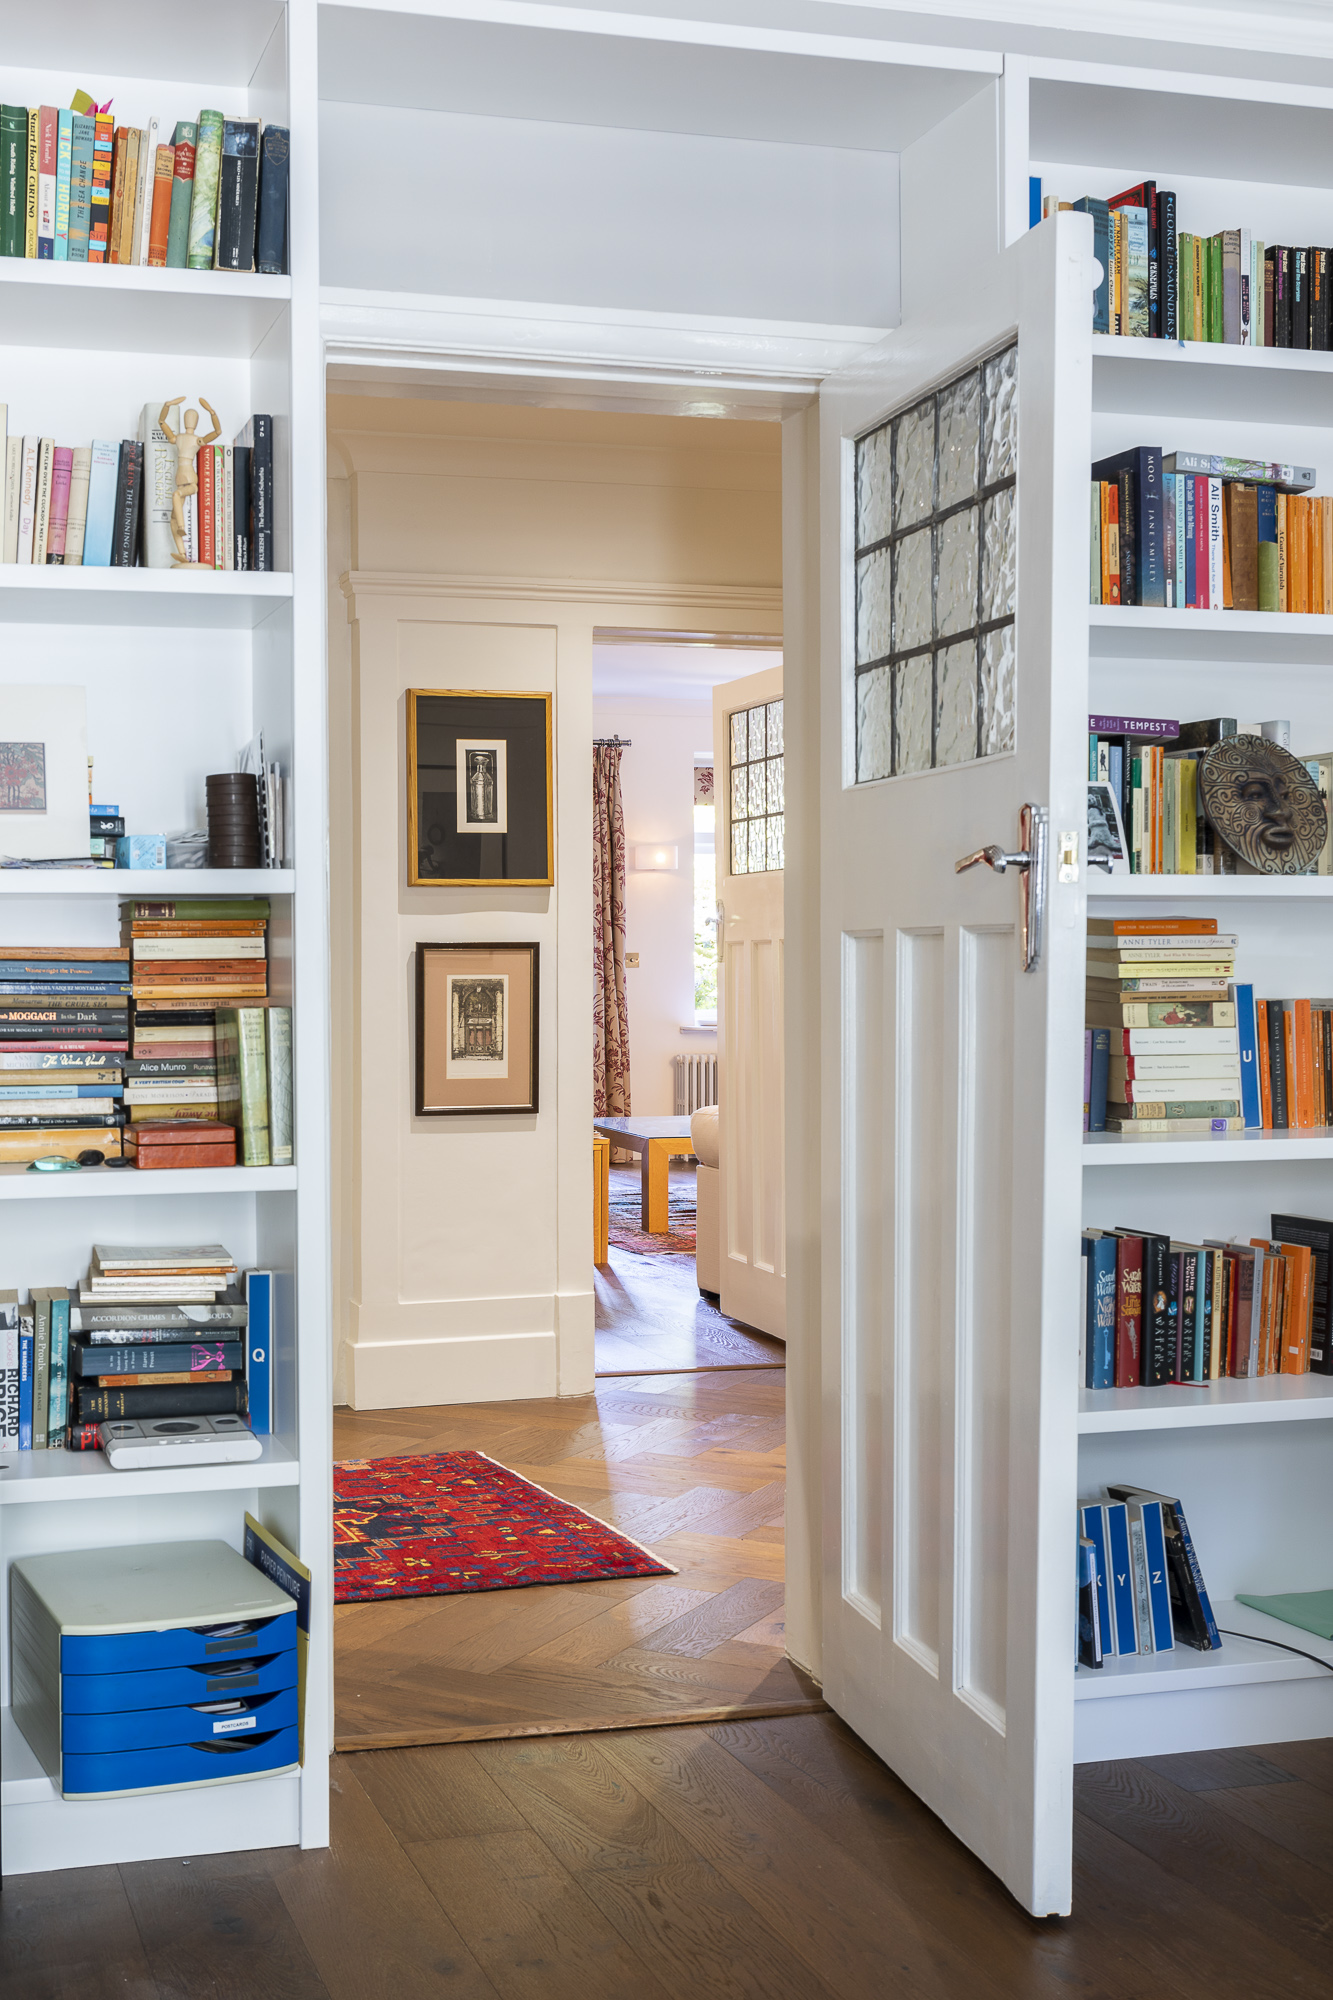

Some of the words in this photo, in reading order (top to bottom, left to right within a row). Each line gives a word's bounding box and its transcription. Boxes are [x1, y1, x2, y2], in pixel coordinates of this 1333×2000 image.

[60, 127, 71, 159] NICK
[29, 141, 37, 172] Hood
[43, 143, 51, 165] Hornby
[56, 184, 70, 240] HORNBY
[77, 205, 85, 219] THE
[1166, 203, 1175, 252] GEORGE
[1150, 261, 1158, 300] PERSEPOLIS
[1166, 269, 1175, 333] SAUNDERS
[1182, 457, 1198, 467] Ali
[126, 489, 134, 505] THE
[1210, 484, 1219, 501] Ali
[21, 518, 31, 535] Day
[122, 507, 132, 548] RUNNING
[1211, 504, 1220, 542] Smith
[122, 551, 131, 567] MAT
[1278, 552, 1286, 561] of
[1123, 721, 1168, 732] TEMPEST
[8, 1012, 57, 1021] MOGGACH
[77, 1013, 98, 1021] Dark
[42, 1054, 58, 1068] The
[1242, 1050, 1252, 1063] U
[140, 1063, 159, 1072] Alice
[161, 1063, 186, 1071] Munro
[1157, 1243, 1166, 1286] Fingersmith
[1123, 1268, 1142, 1282] Sarah
[90, 1314, 136, 1322] ACCORDION
[38, 1314, 47, 1341] Annie
[38, 1343, 46, 1371] Proulx
[252, 1348, 265, 1363] Q
[7, 1368, 19, 1437] RICHARD
[261, 1550, 278, 1577] PAPIER
[276, 1567, 301, 1599] PEINTURE
[1117, 1573, 1126, 1586] Y
[1152, 1571, 1162, 1585] Z
[1192, 1566, 1202, 1593] UNIVERSE
[221, 1721, 249, 1730] POSTCARDS
